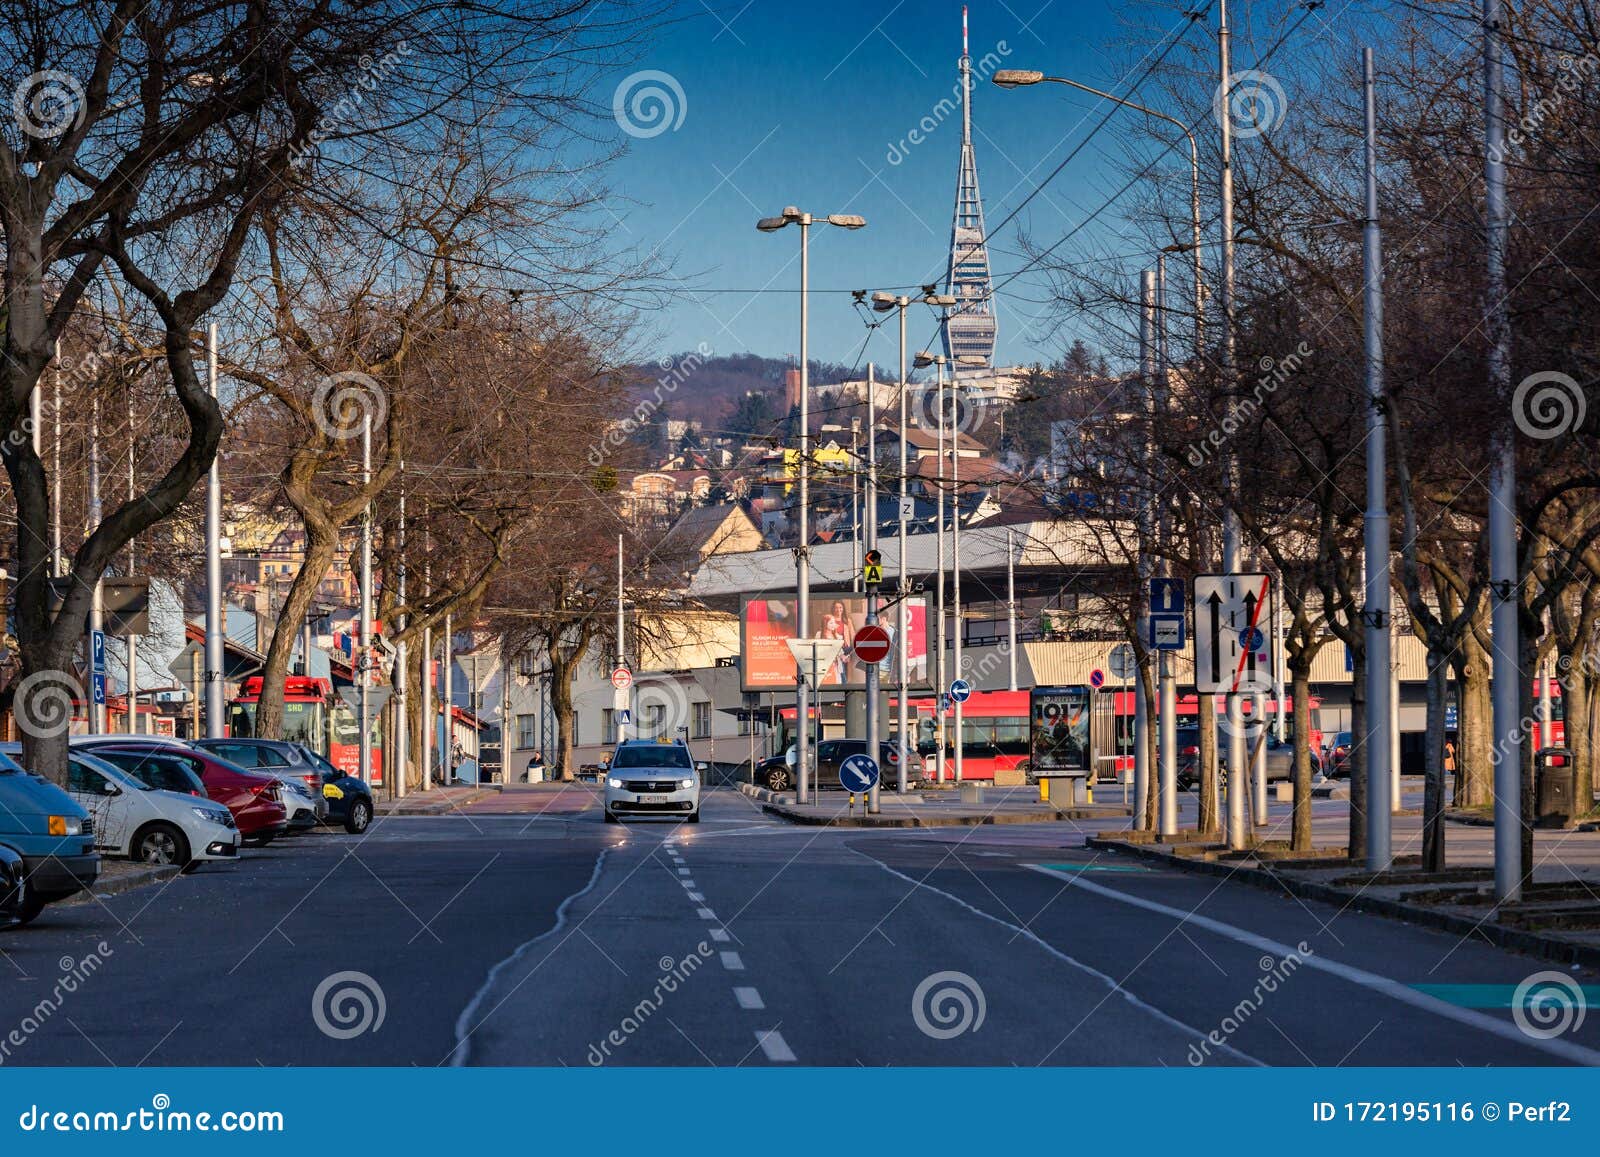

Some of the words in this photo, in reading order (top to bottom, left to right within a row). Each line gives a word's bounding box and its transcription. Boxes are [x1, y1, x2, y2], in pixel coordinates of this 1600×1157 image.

[903, 504, 911, 514] Z
[867, 567, 880, 581] A
[96, 635, 102, 657] P
[1036, 703, 1086, 726] 1917
